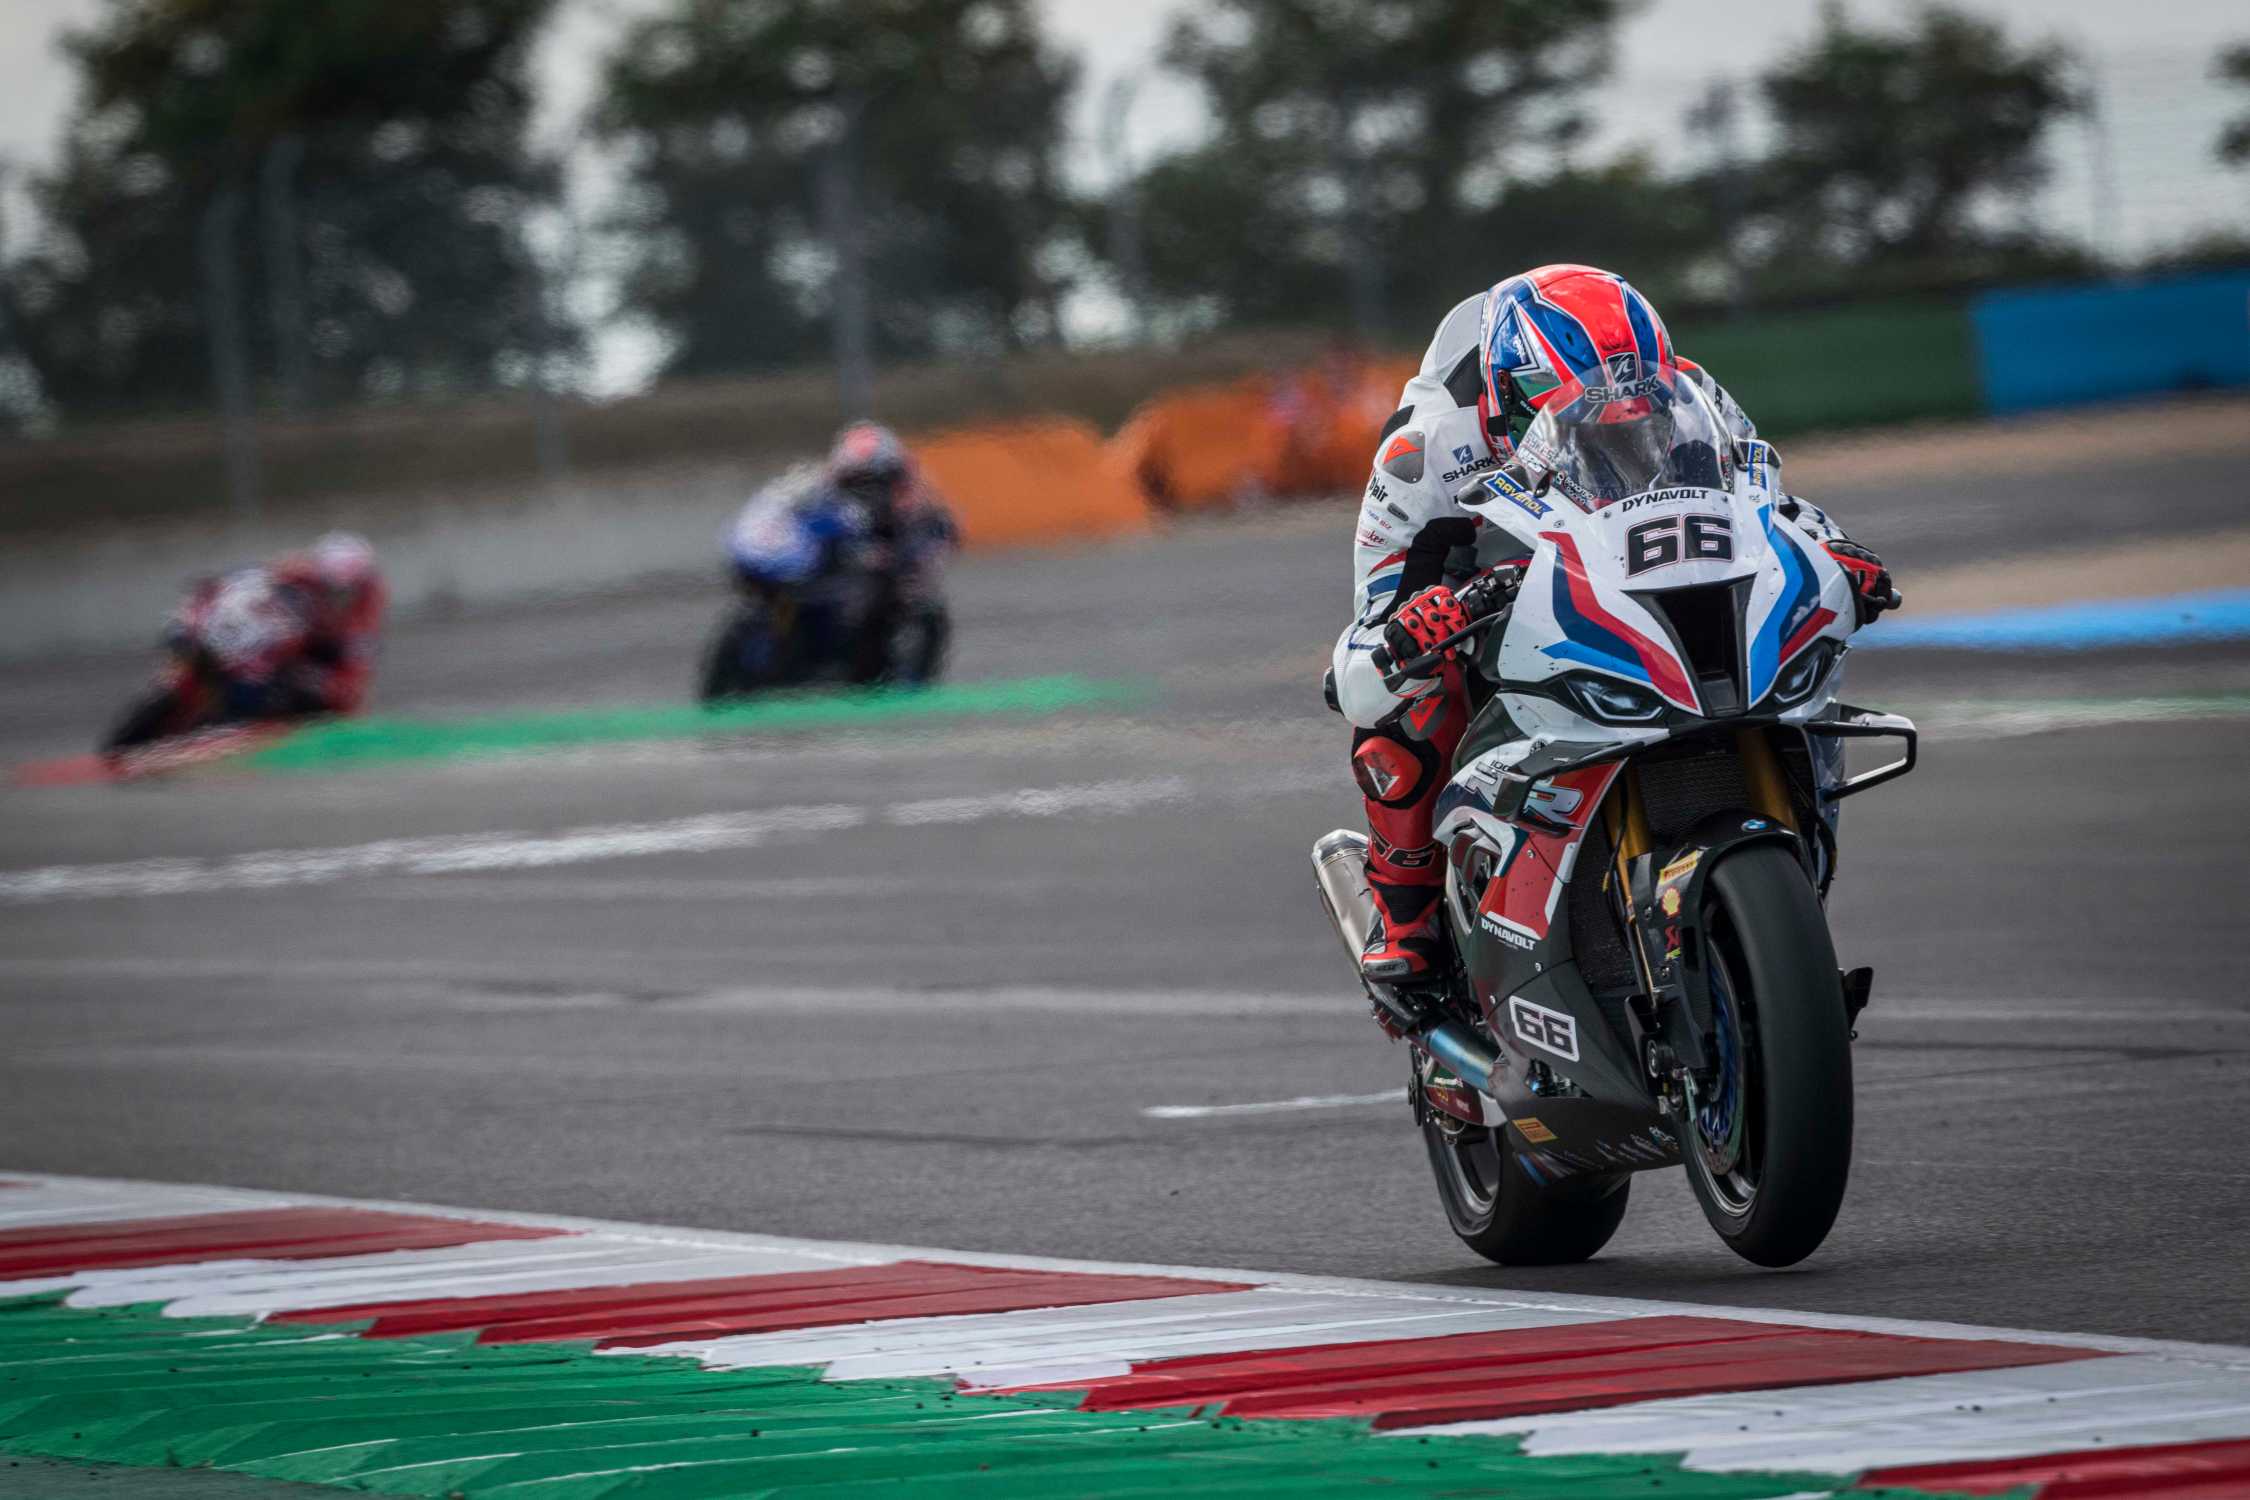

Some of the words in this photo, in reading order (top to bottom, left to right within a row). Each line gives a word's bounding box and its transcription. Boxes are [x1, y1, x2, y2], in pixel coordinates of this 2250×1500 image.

[1585, 375, 1660, 403] SHARK
[1442, 455, 1496, 483] SHARK
[1494, 476, 1543, 513] RAVENOL
[1622, 488, 1708, 513] DYNAVOLT
[1626, 514, 1733, 577] 66
[1481, 918, 1536, 950] DYNAVOLT
[1514, 1002, 1574, 1054] 66
